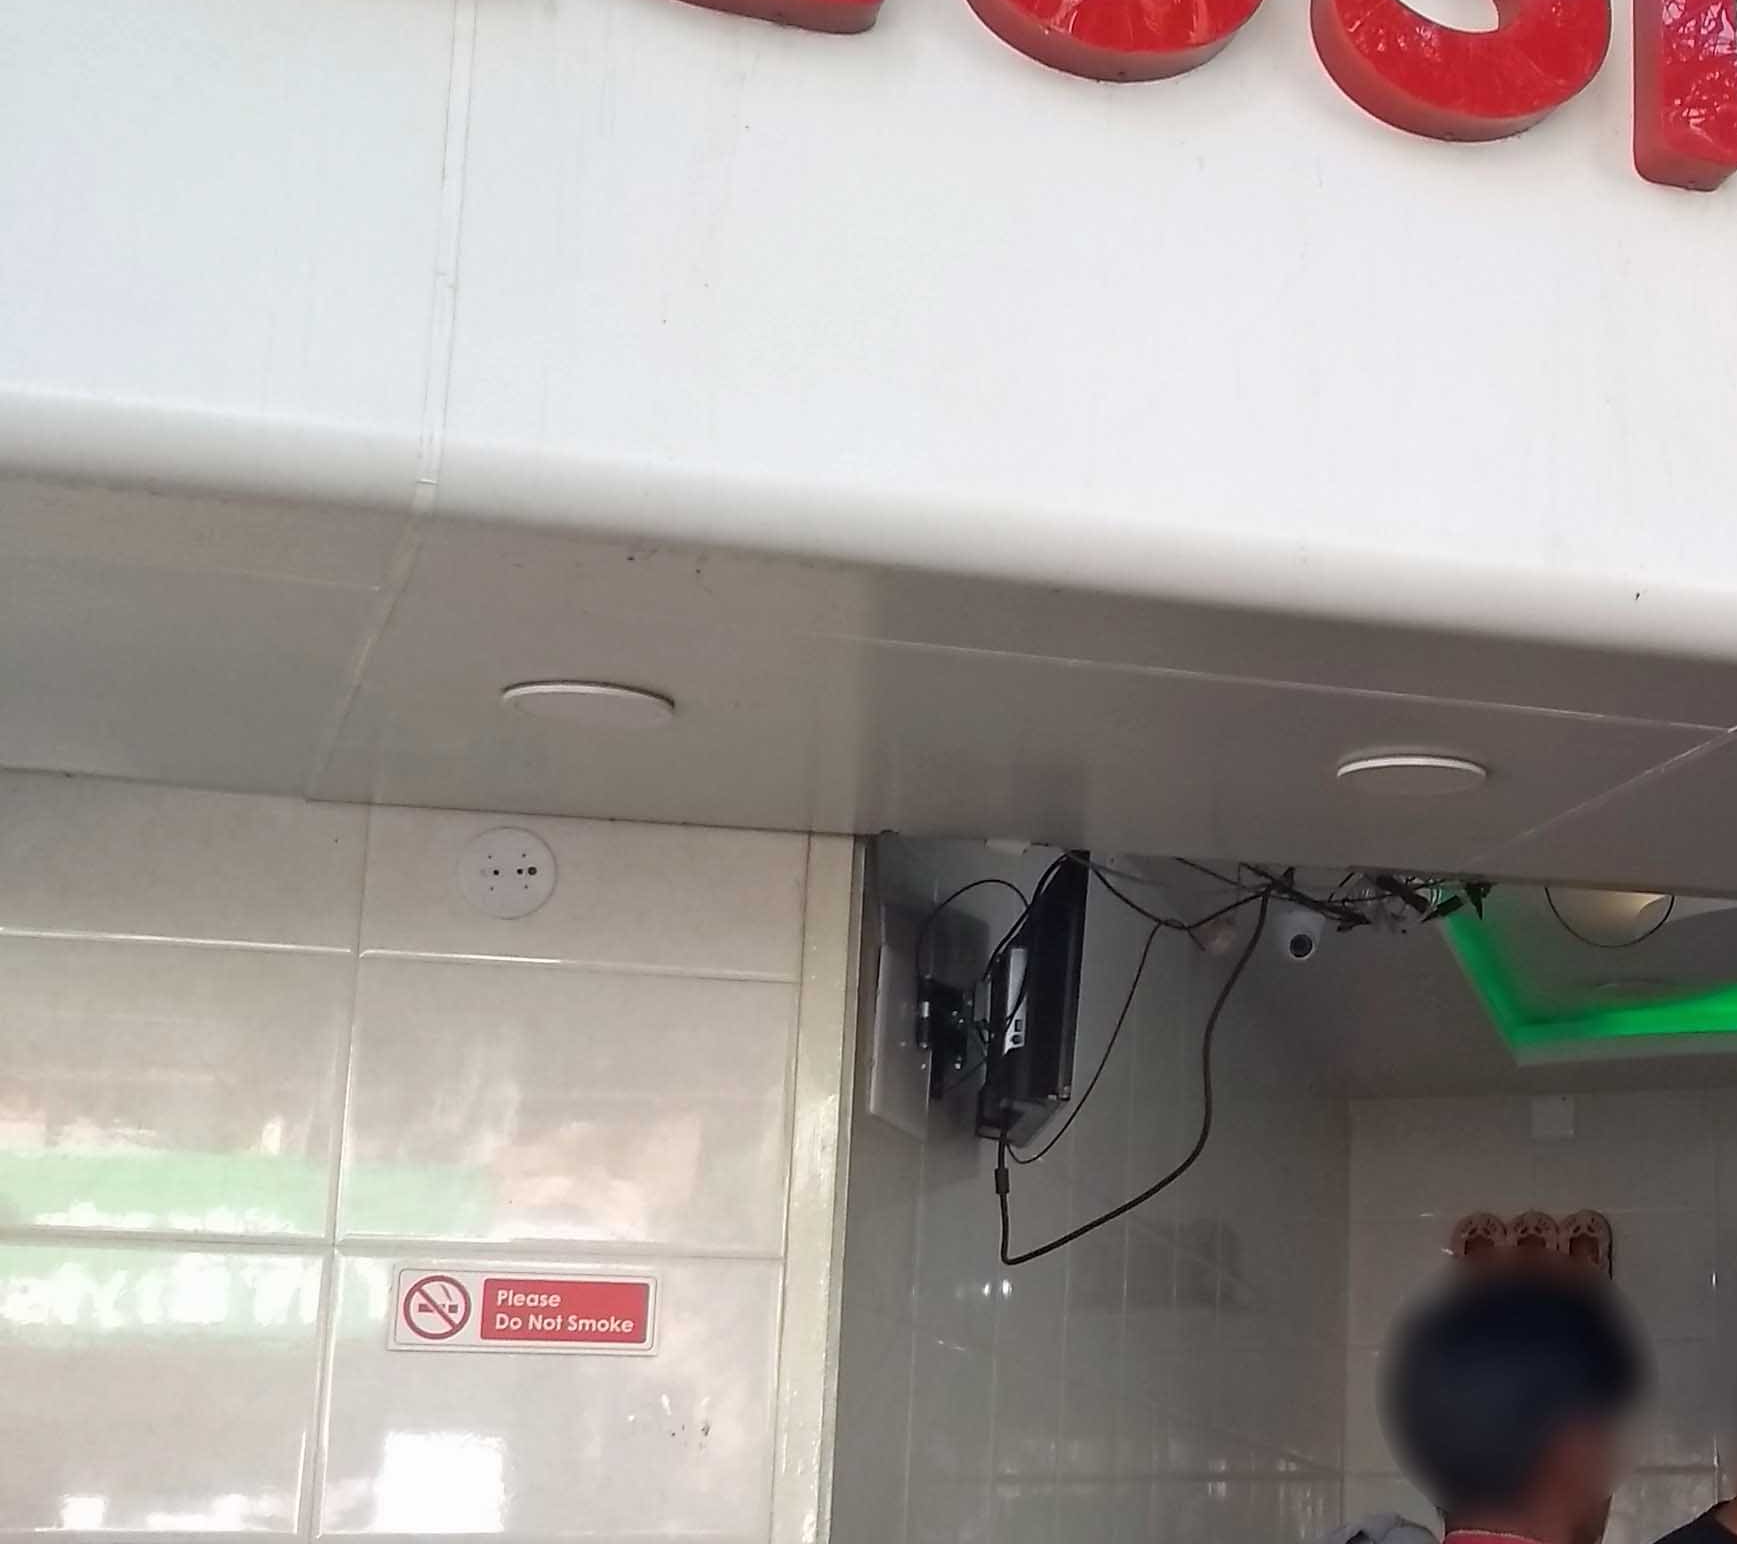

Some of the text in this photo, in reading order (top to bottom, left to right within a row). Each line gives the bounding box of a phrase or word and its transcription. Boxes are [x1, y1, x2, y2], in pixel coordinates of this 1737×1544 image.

[497, 1290, 561, 1307] Please
[495, 1314, 634, 1333] Do Not Smoke
